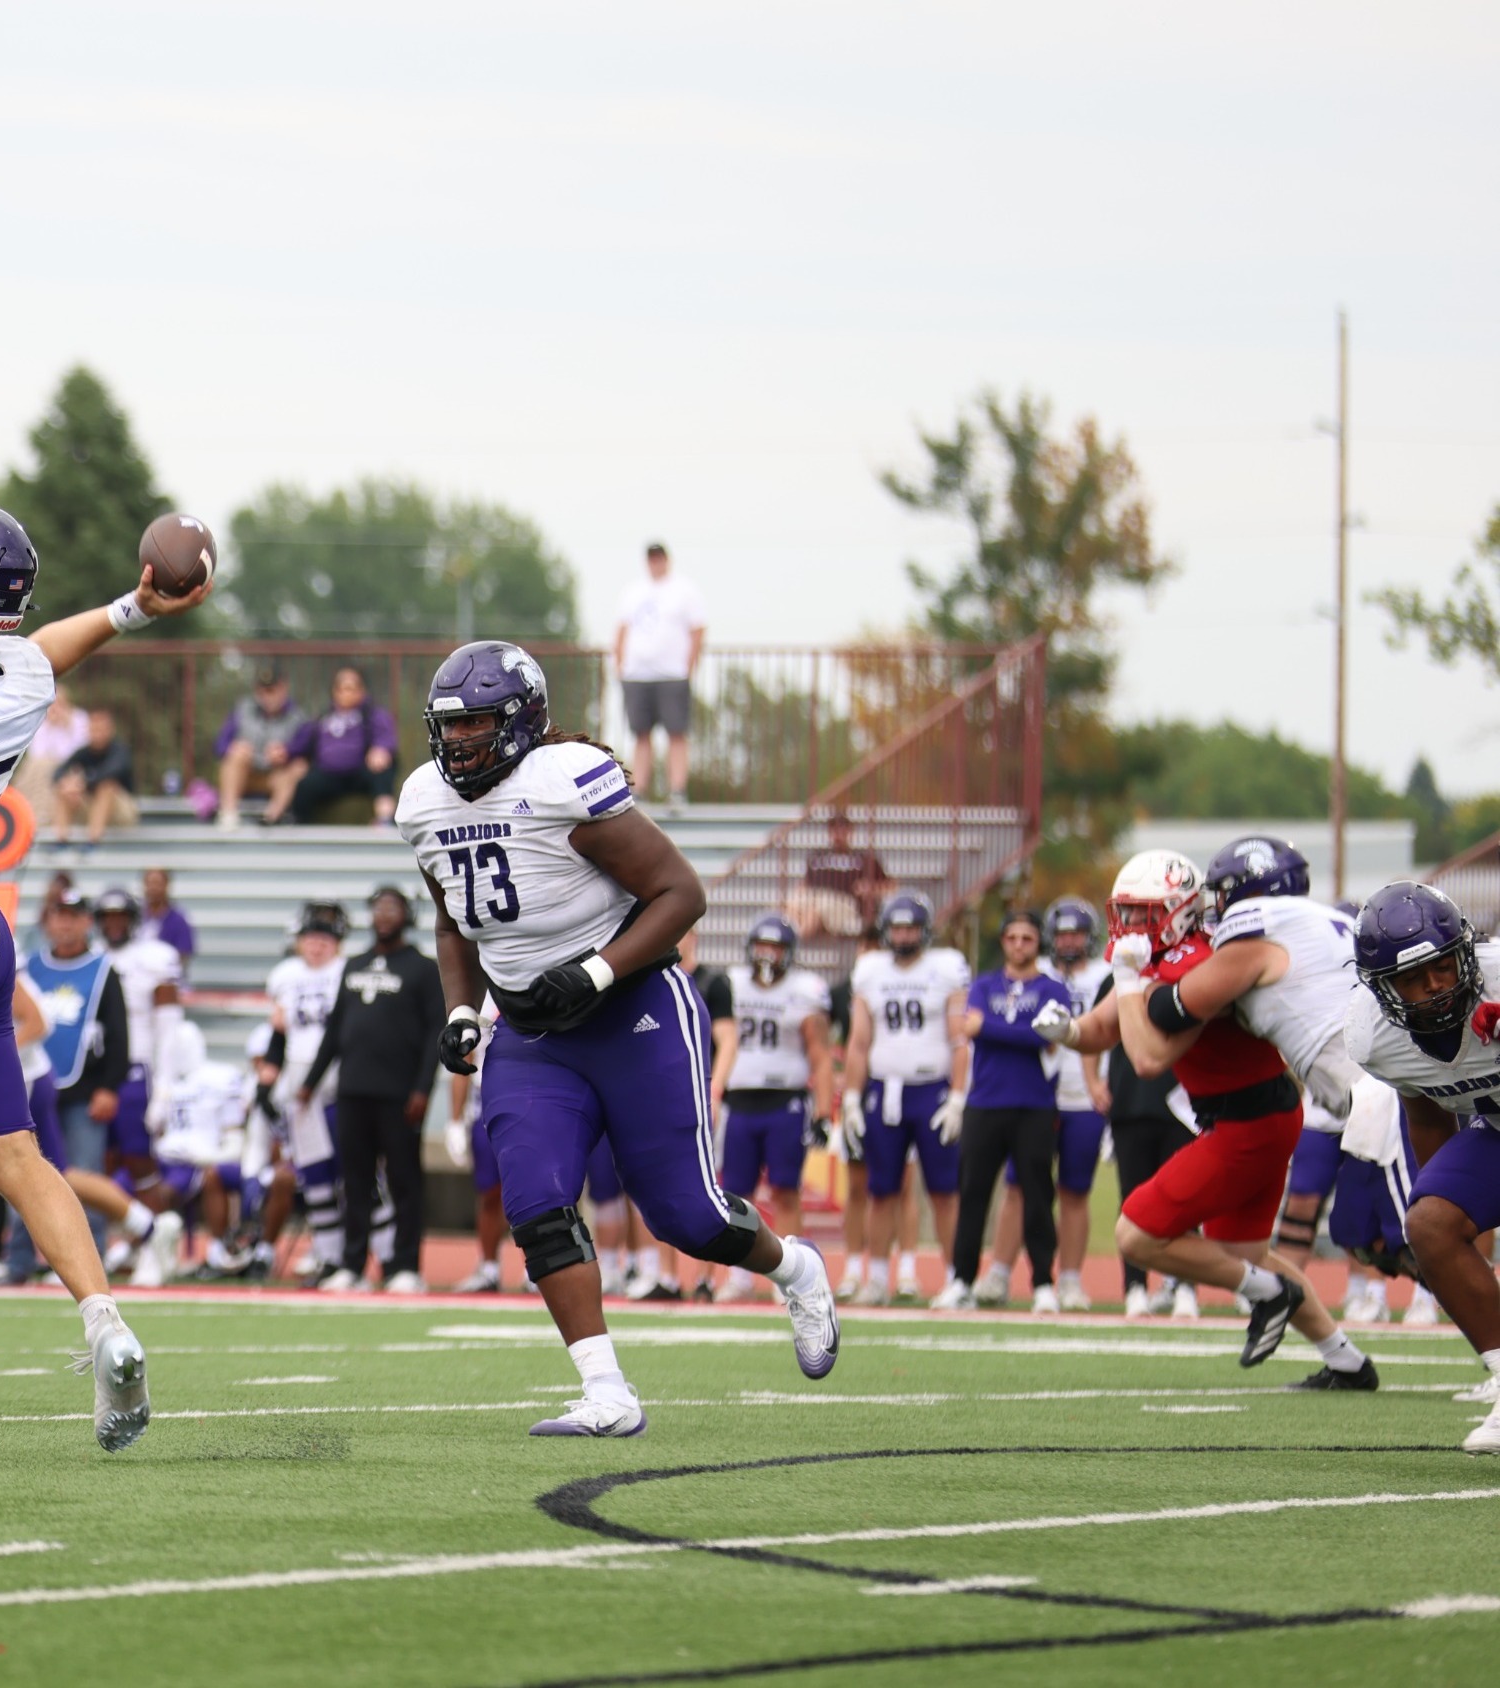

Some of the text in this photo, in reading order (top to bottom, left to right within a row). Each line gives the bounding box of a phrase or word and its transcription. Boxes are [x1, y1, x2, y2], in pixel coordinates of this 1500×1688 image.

[435, 823, 511, 847] WARRIORS
[448, 842, 520, 929] 73
[1417, 1072, 1500, 1098] WARRIOR
